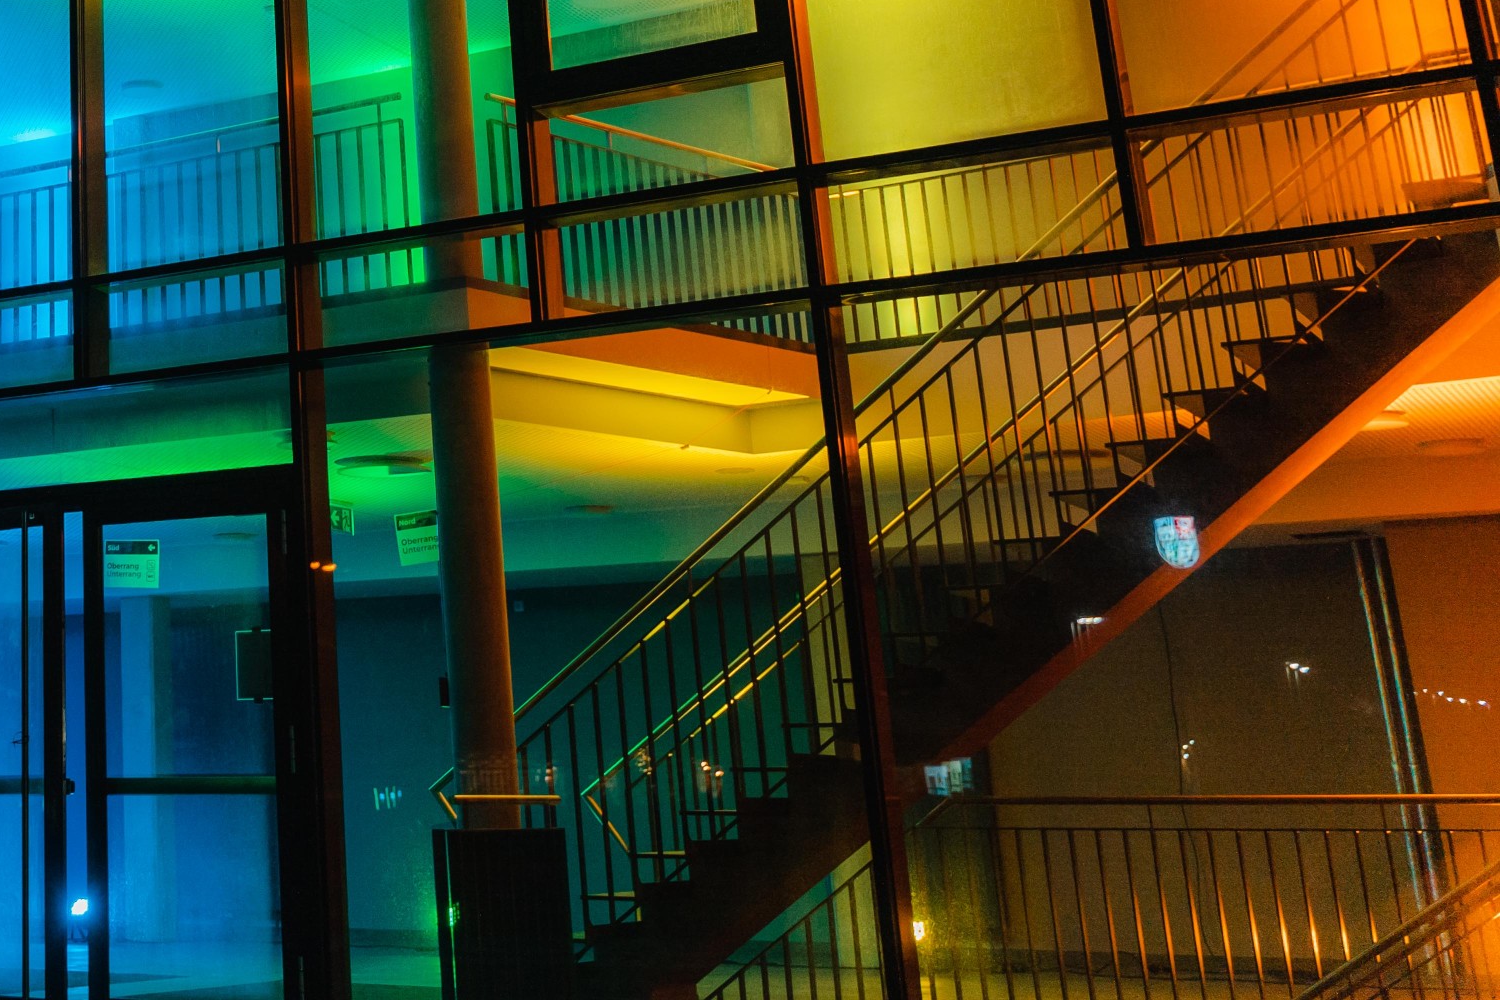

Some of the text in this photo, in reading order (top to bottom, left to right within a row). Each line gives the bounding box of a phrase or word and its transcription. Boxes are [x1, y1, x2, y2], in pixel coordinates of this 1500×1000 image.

[398, 517, 416, 527] Nord
[402, 544, 439, 554] Unterran
[107, 562, 139, 571] Oberrang
[107, 571, 141, 579] Unterrang
